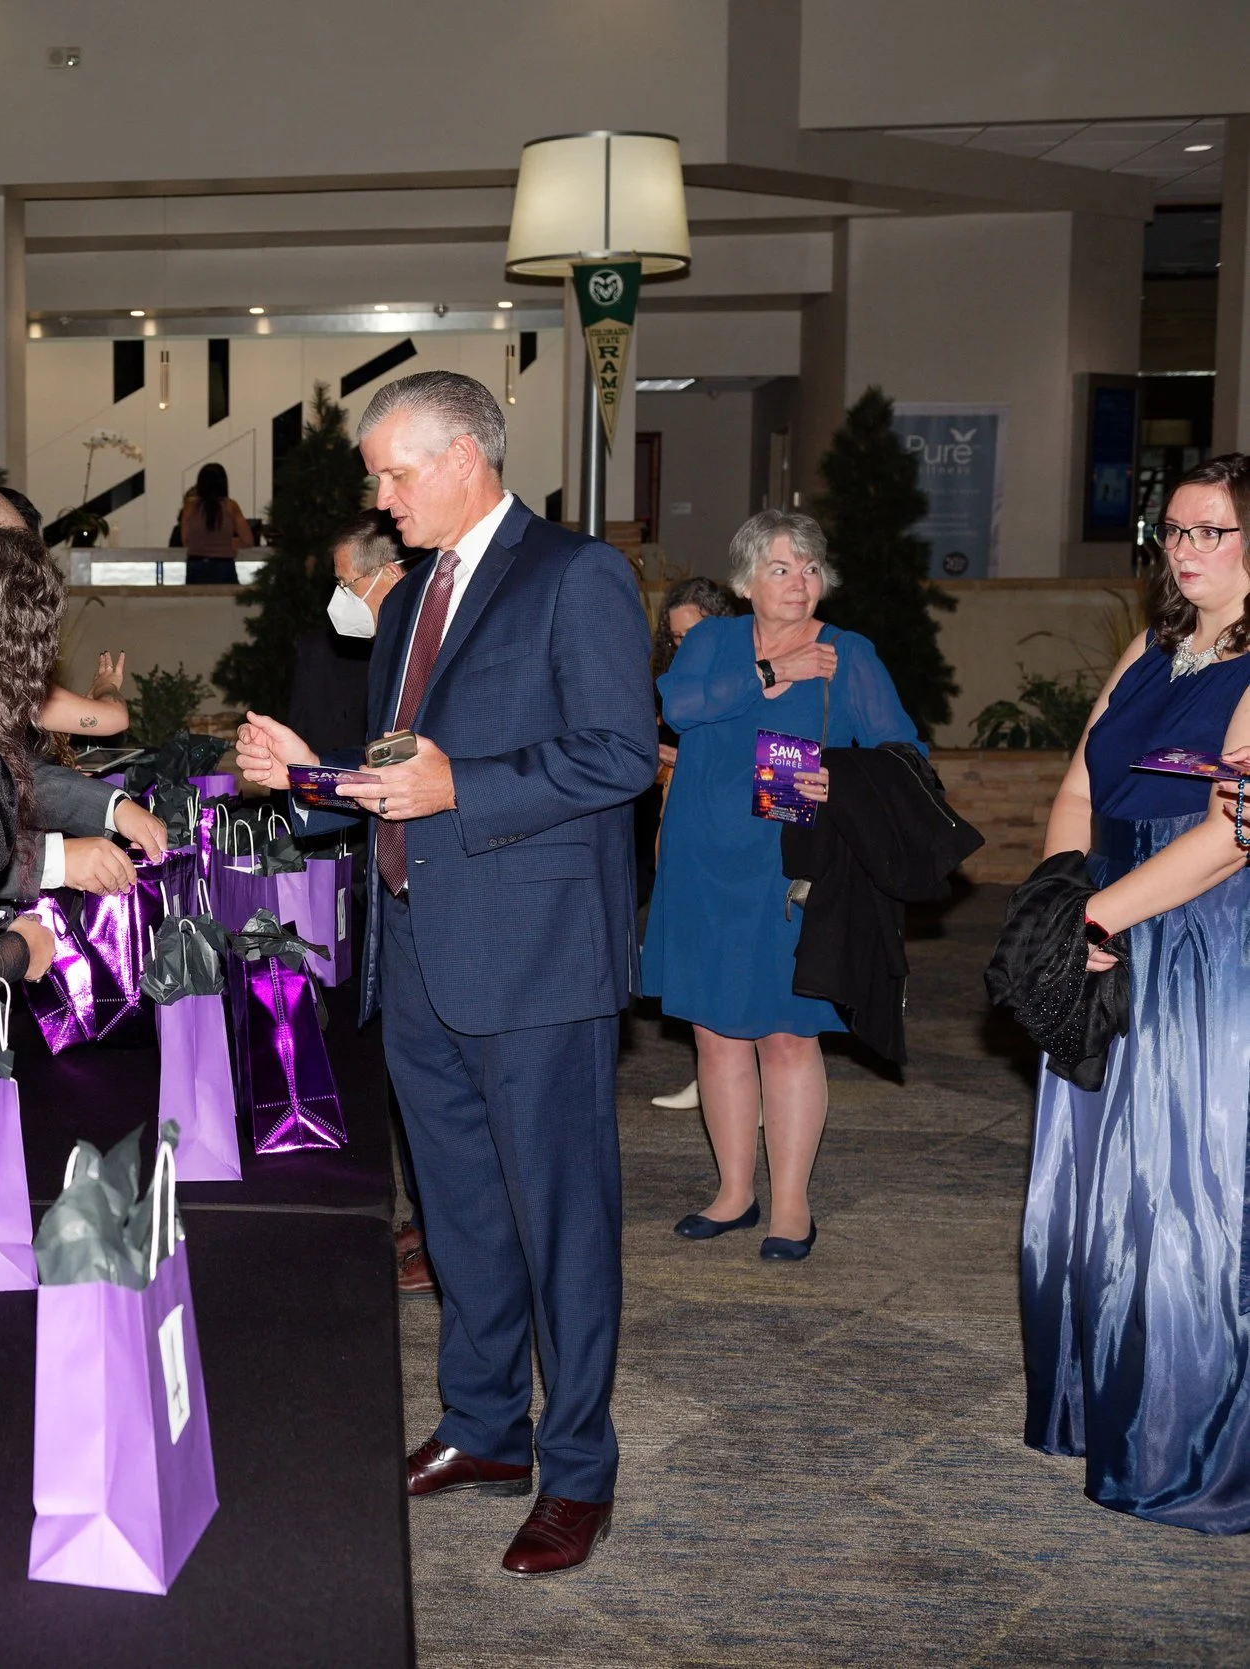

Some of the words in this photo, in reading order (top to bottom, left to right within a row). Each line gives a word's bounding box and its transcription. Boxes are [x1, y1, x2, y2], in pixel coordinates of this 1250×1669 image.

[598, 346, 619, 404] RAMS
[769, 743, 802, 762] SAVA
[308, 771, 354, 780] SAVA
